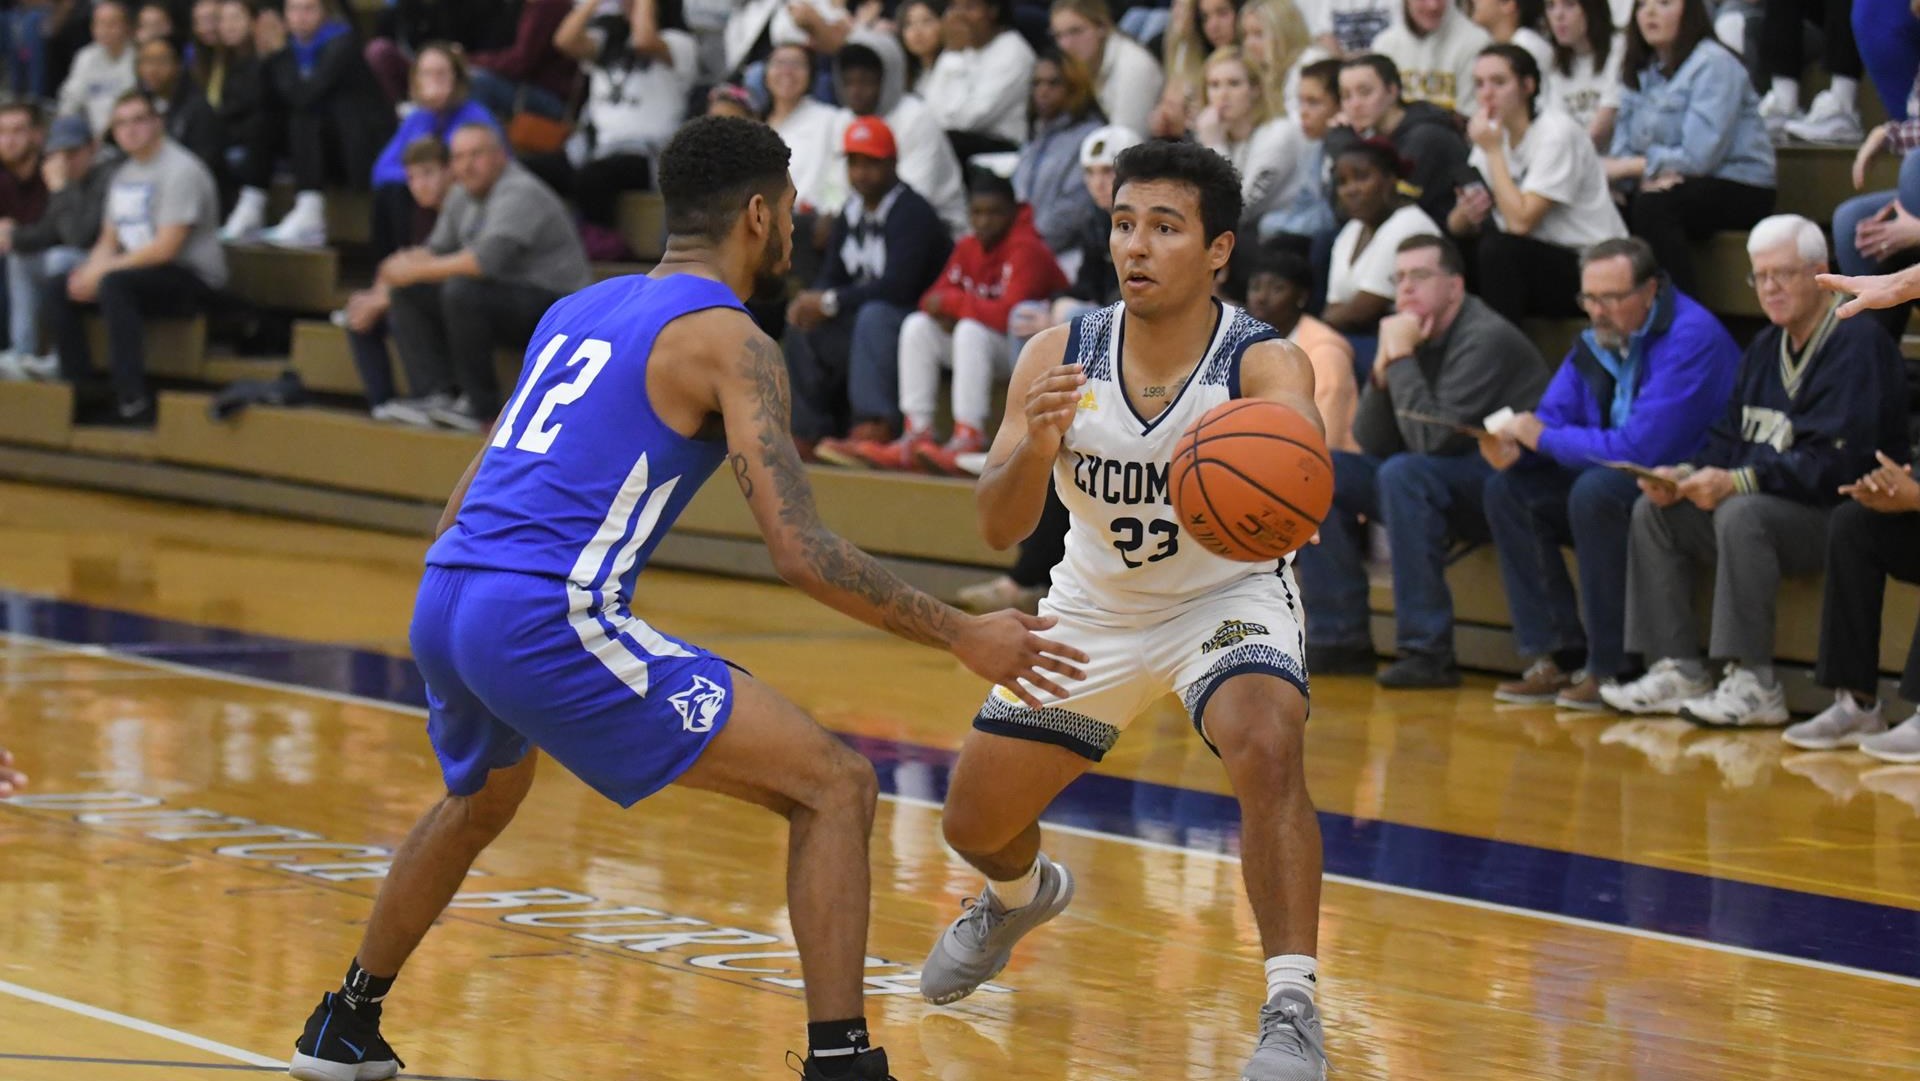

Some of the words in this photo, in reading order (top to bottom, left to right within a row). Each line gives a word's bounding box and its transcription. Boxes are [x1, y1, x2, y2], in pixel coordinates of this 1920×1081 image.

[491, 333, 612, 454] 12
[1073, 451, 1173, 506] LYCOM
[1110, 517, 1179, 569] 23
